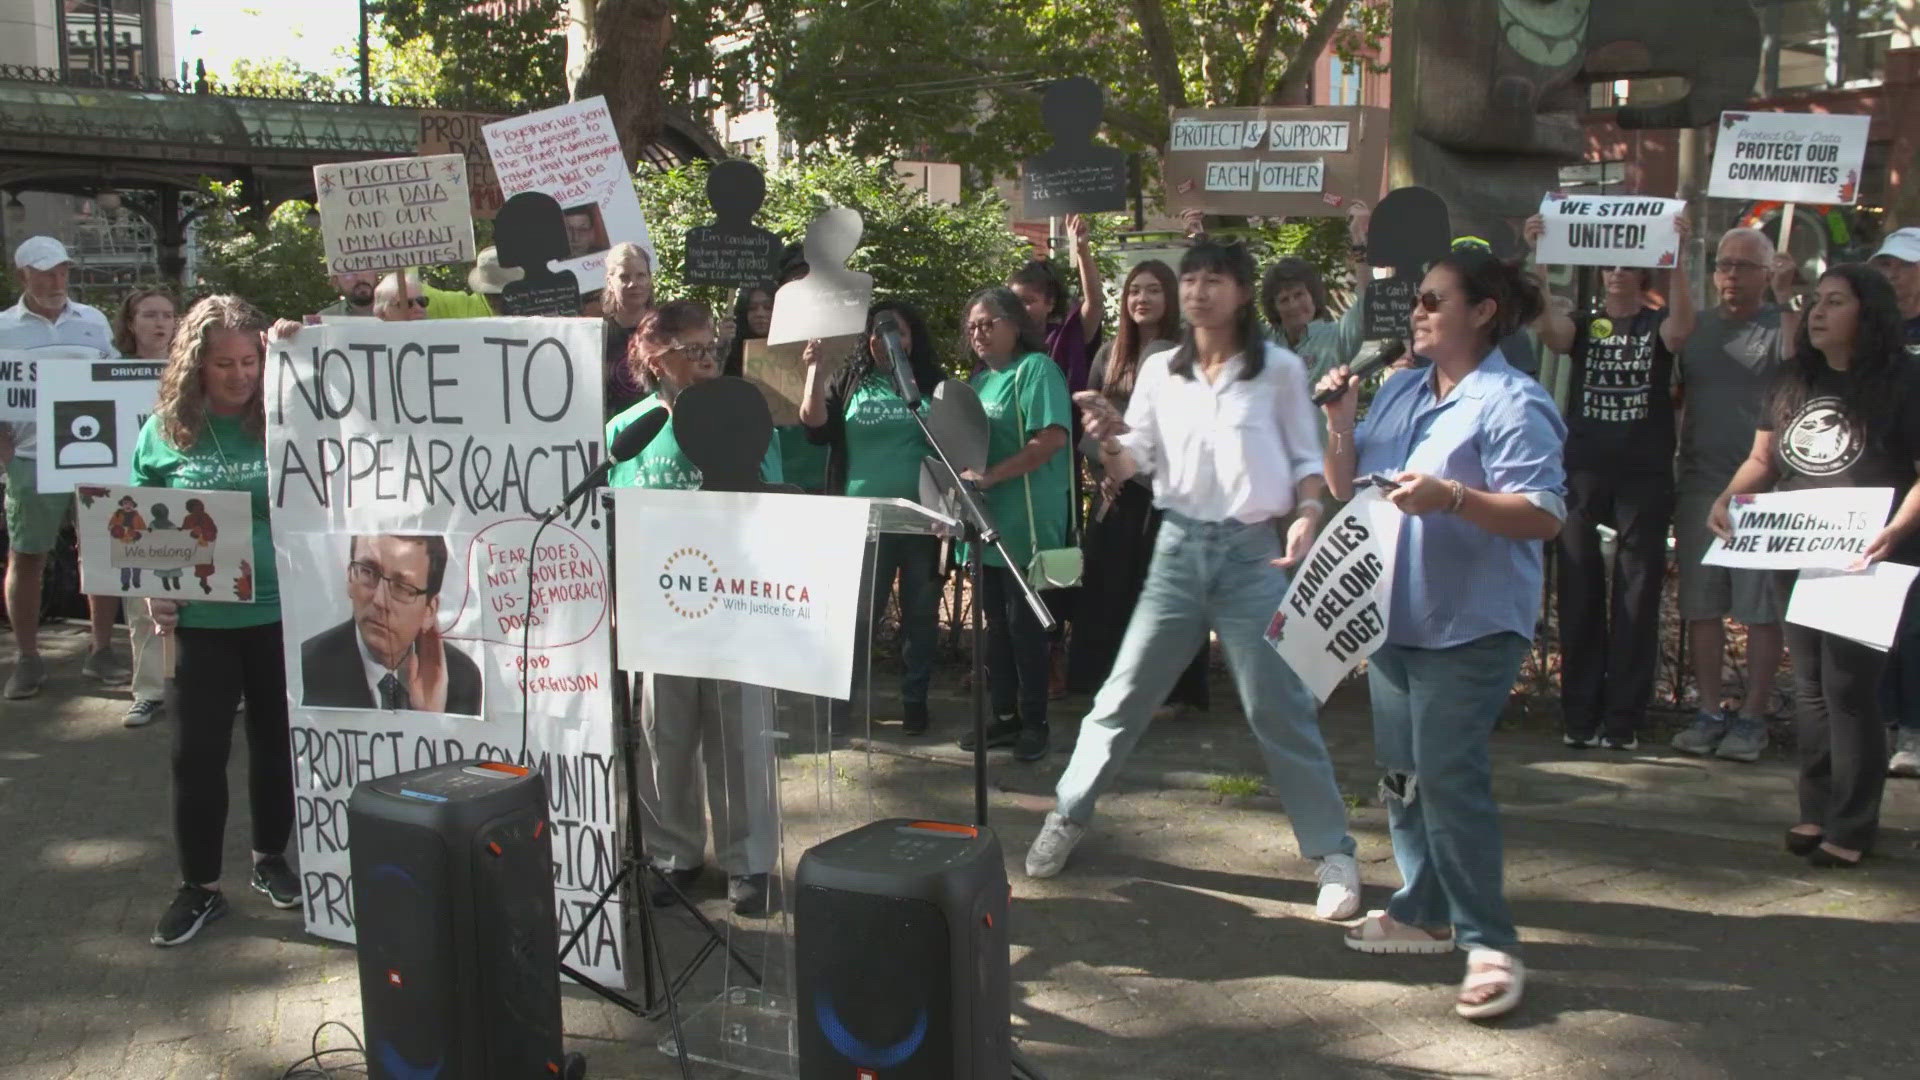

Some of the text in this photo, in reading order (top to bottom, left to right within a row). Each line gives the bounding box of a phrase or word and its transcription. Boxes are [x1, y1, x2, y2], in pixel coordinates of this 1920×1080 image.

[1174, 123, 1347, 147] PROTECT & SUPPORT
[1737, 129, 1841, 143] Protect Our Data
[1736, 142, 1839, 162] PROTECT OUR
[340, 161, 432, 186] PROTECT
[1208, 165, 1319, 187] EACH OTHER
[1728, 163, 1839, 185] COMMUNITIES
[349, 189, 390, 207] OUR
[399, 183, 449, 203] DATA
[345, 206, 437, 231] AND OUR
[1560, 201, 1664, 216] WE STAND
[338, 226, 455, 252] IMMIGRANT
[1569, 223, 1645, 249] UNITED!
[332, 240, 464, 273] COMMUNITIES!
[111, 368, 151, 377] DRIVER
[277, 337, 573, 425] NOTICE TO
[7, 387, 37, 408] UNI
[1584, 391, 1649, 408] FILL THE
[125, 544, 198, 561] We belong!
[537, 544, 579, 563] DOES
[1722, 536, 1867, 554] ARE WELCOME
[1290, 515, 1370, 617] FAMILIES
[487, 569, 517, 588] NOT
[531, 580, 604, 609] DEMOCRACY
[1313, 553, 1384, 631] BELONG
[723, 598, 811, 620] With Justice for All
[1326, 601, 1385, 663] TOGET
[290, 727, 404, 792] PROTECT
